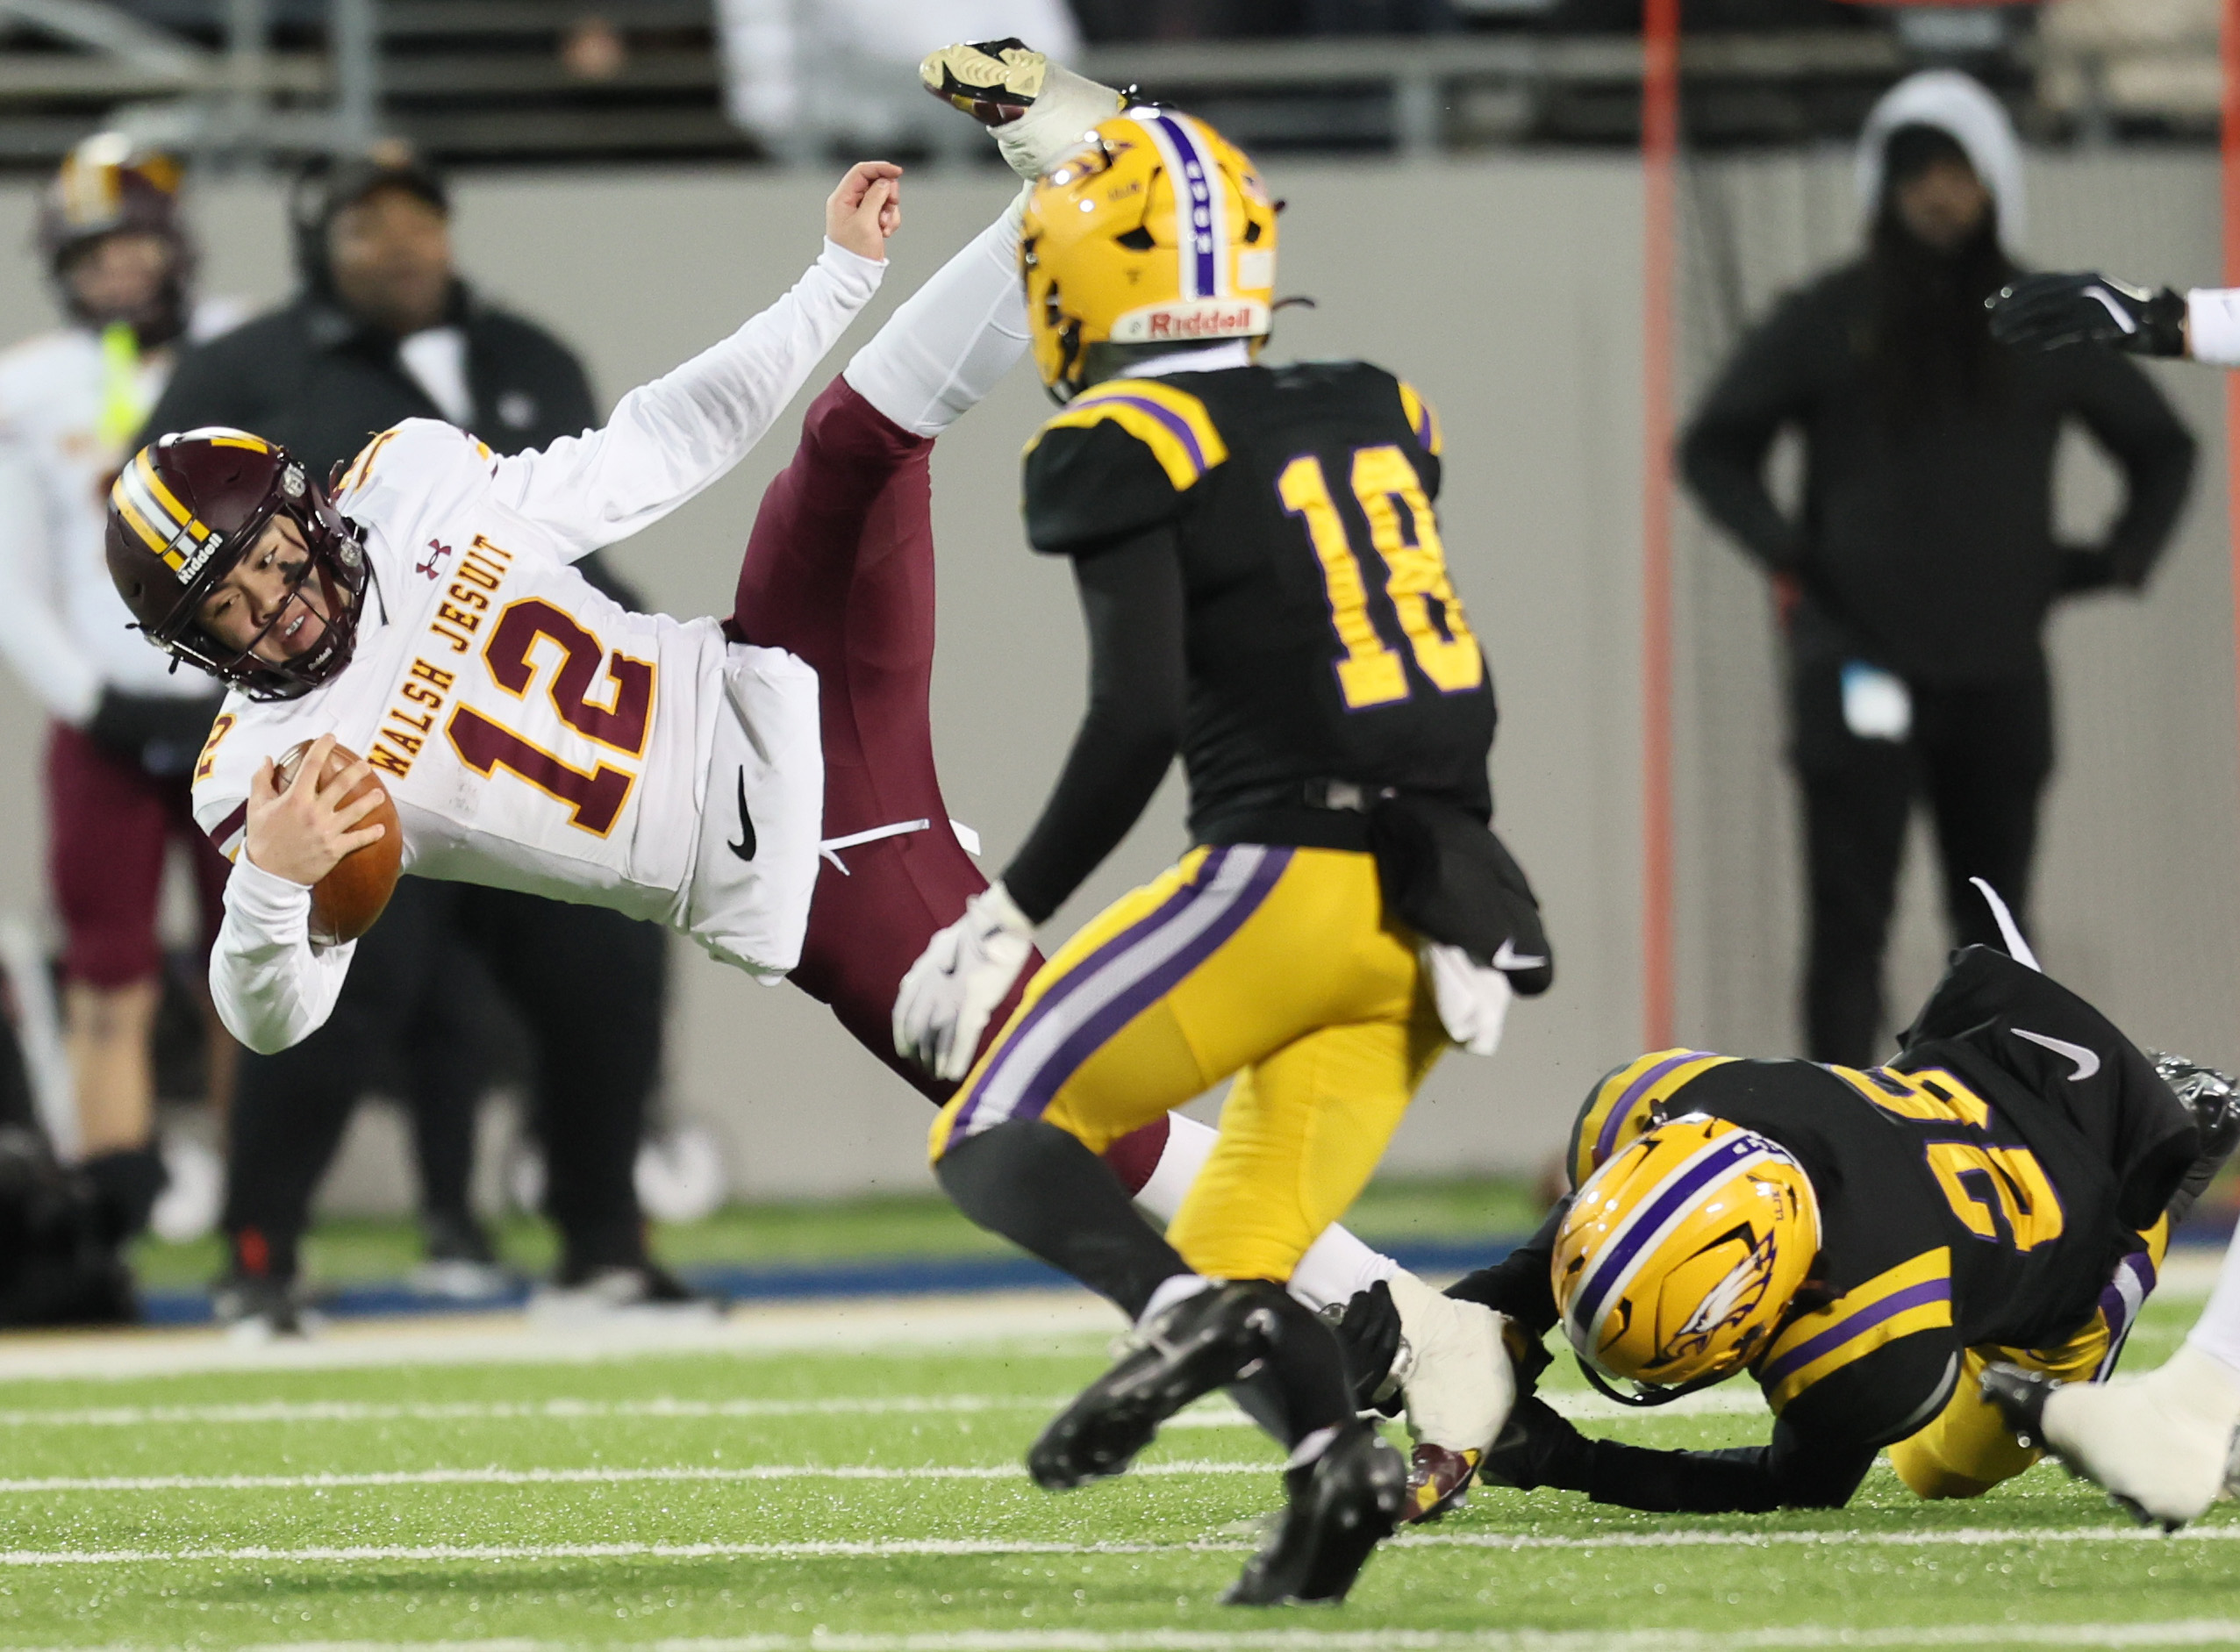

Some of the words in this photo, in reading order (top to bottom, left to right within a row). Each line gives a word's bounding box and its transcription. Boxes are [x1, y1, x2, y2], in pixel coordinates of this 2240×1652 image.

[367, 656, 456, 781] WALSH
[429, 533, 513, 654] JESUIT
[1274, 441, 1484, 713] 18
[443, 596, 656, 840] 12
